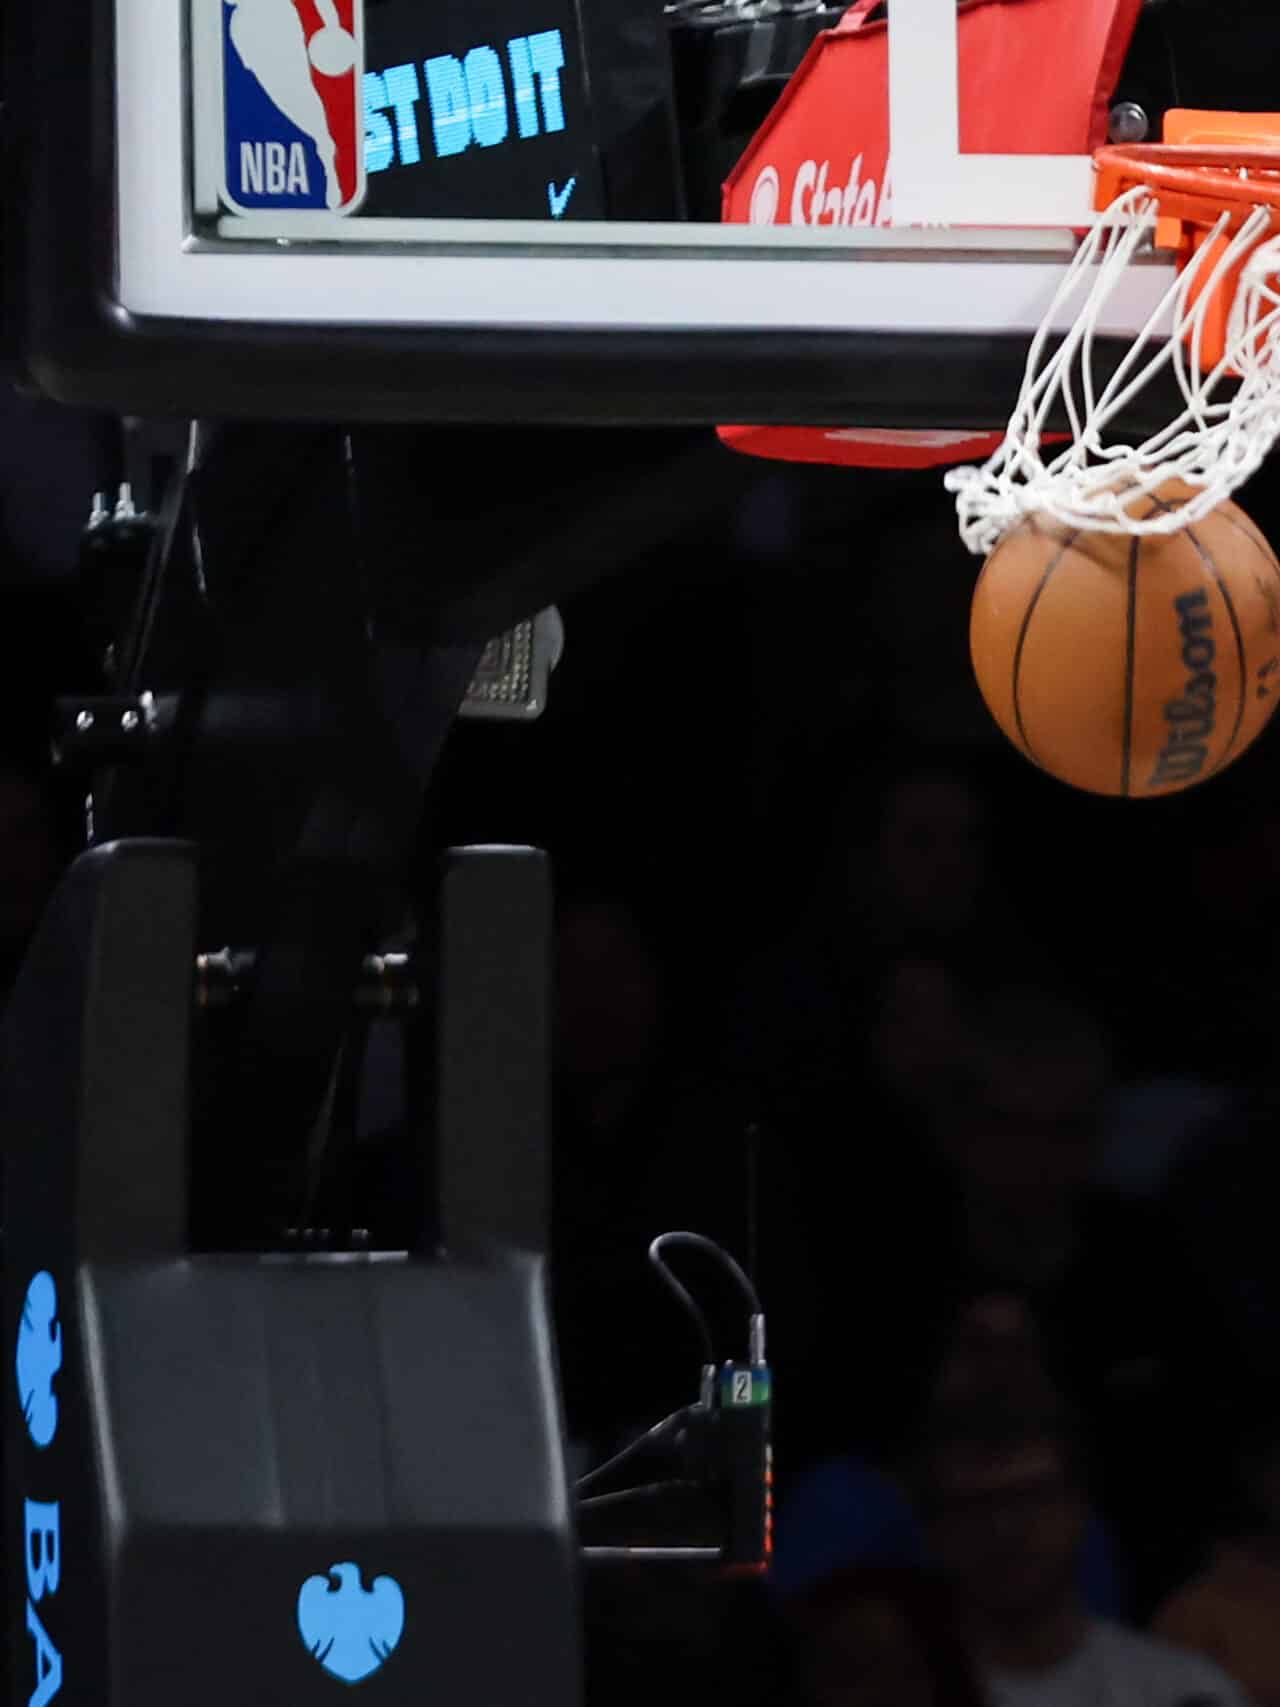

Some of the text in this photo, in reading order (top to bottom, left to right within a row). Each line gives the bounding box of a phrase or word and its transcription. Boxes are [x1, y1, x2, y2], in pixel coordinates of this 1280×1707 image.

[424, 45, 509, 158] DO
[507, 29, 565, 139] IT
[240, 141, 311, 195] NBA
[1148, 588, 1216, 787] Wilson
[736, 1373, 750, 1401] 2
